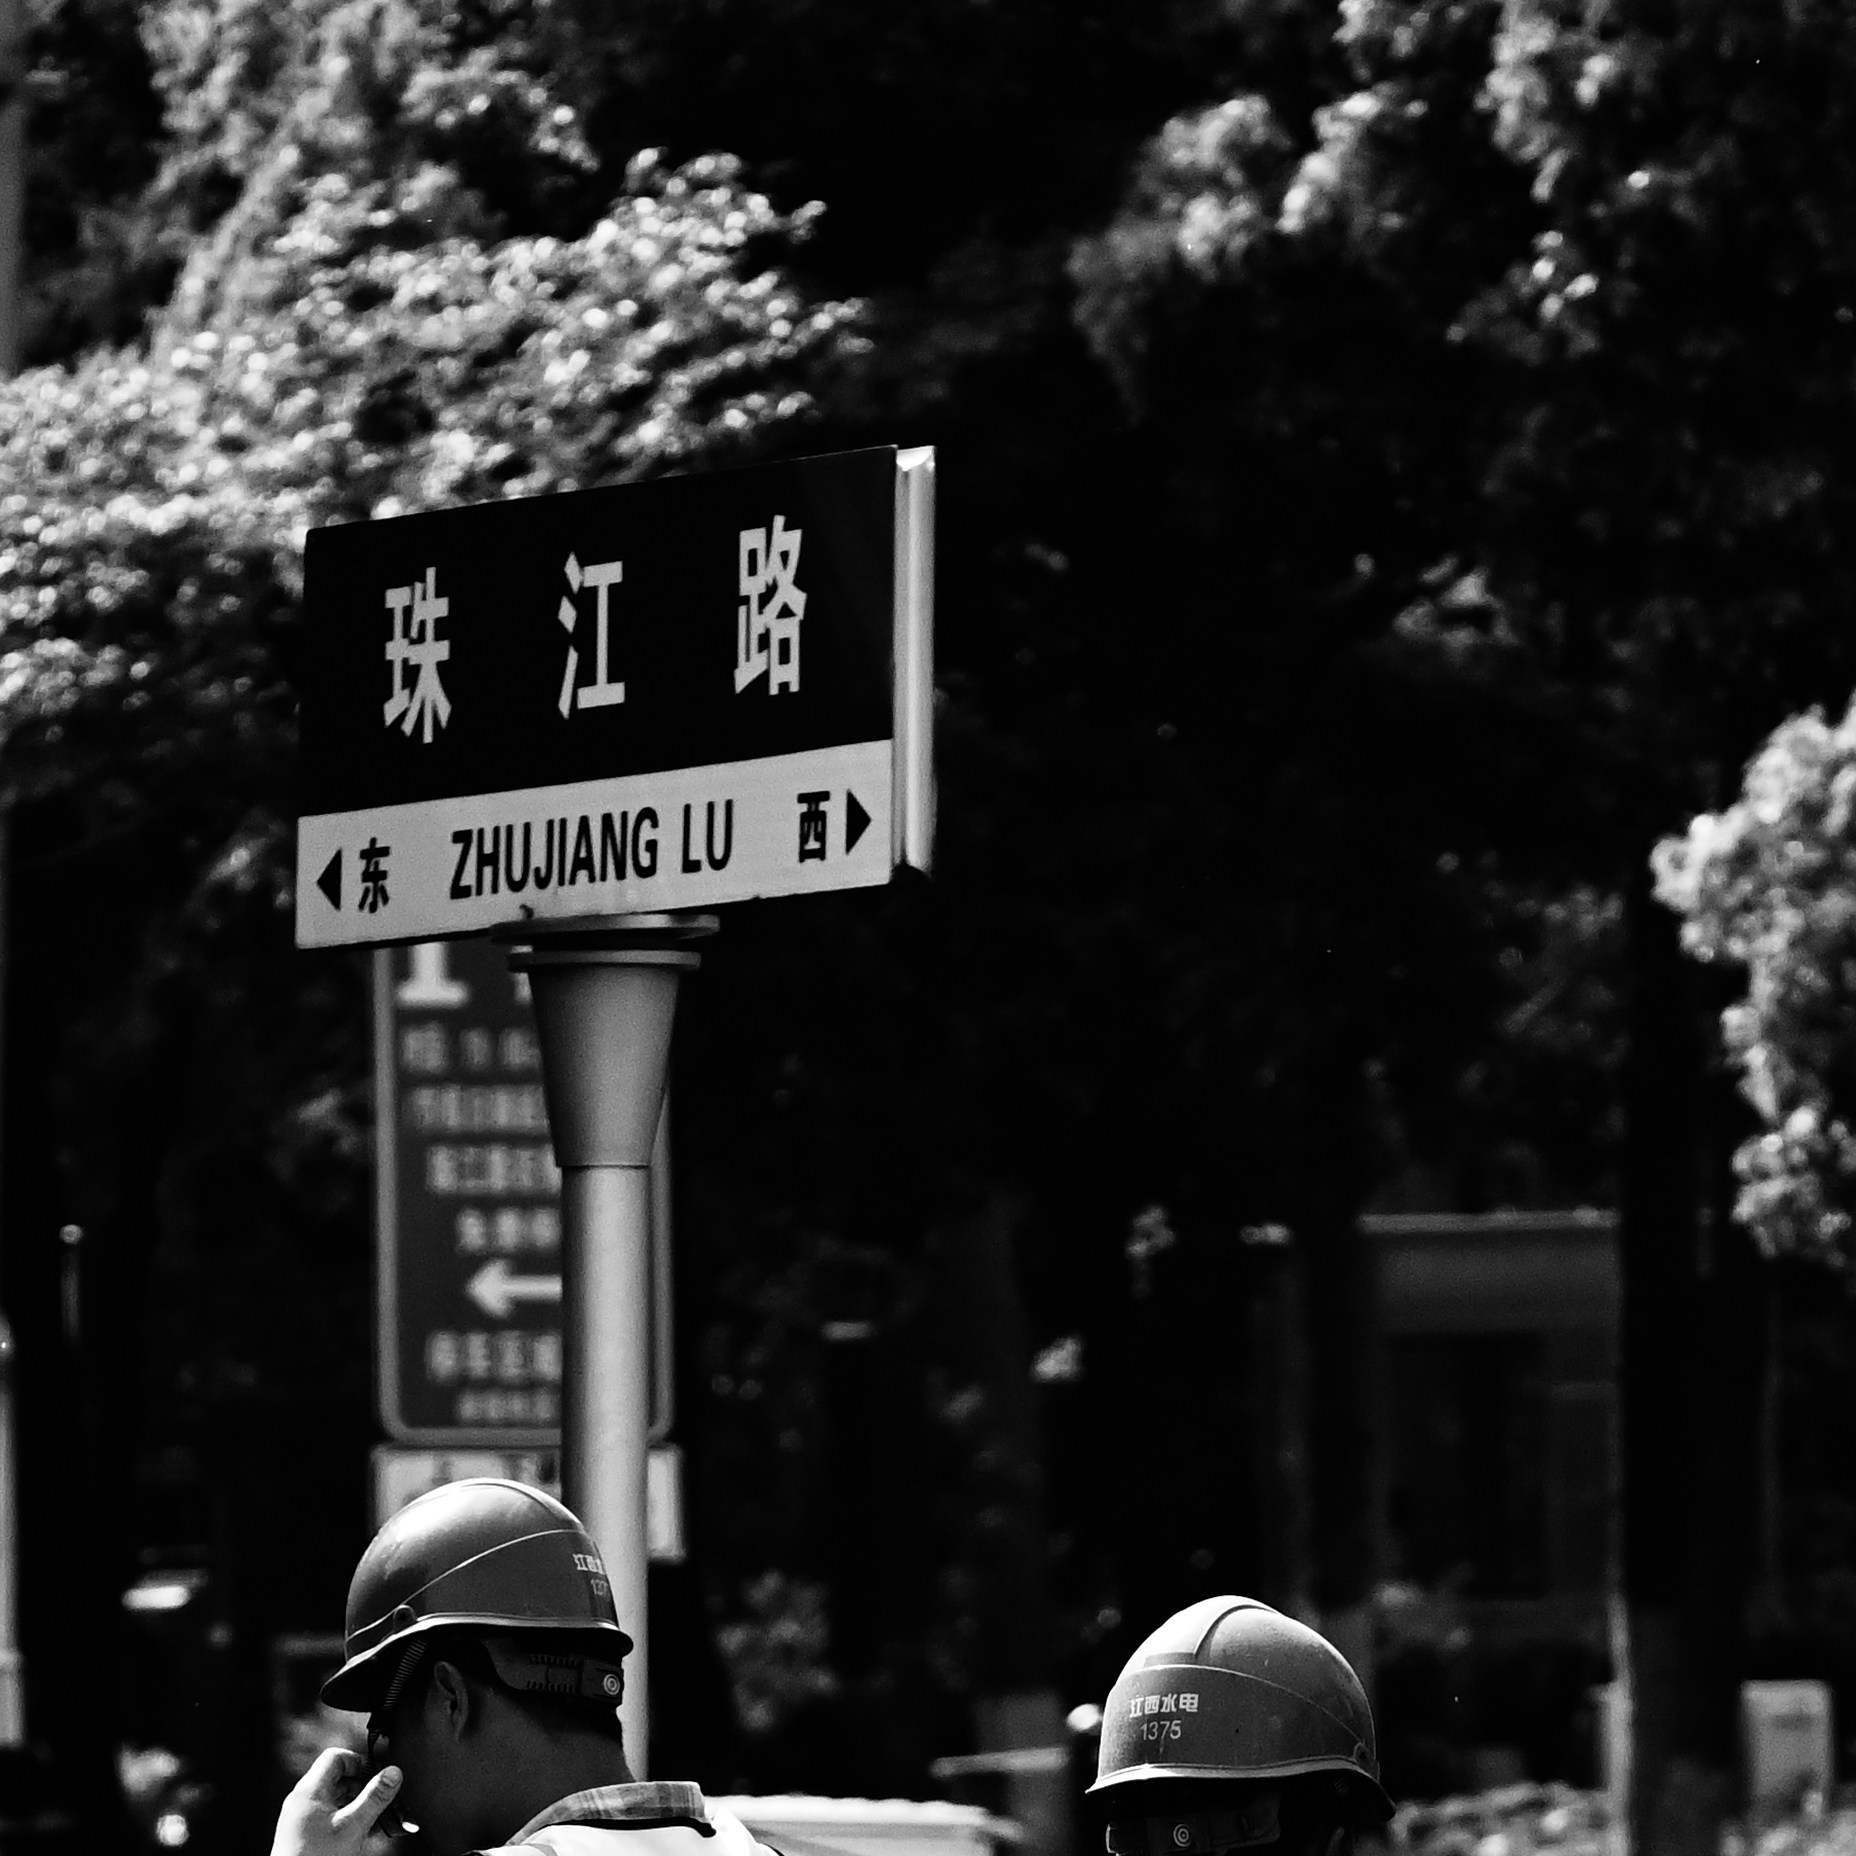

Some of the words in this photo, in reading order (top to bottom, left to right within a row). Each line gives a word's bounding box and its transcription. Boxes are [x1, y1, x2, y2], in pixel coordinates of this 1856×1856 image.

[384, 515, 807, 744] 珠江路
[450, 806, 660, 900] ZHUJIANG
[681, 799, 734, 874] LU
[797, 790, 831, 864] 西
[358, 837, 391, 914] 东
[1129, 1693, 1200, 1718] 江西水电
[1140, 1720, 1182, 1740] 1375
